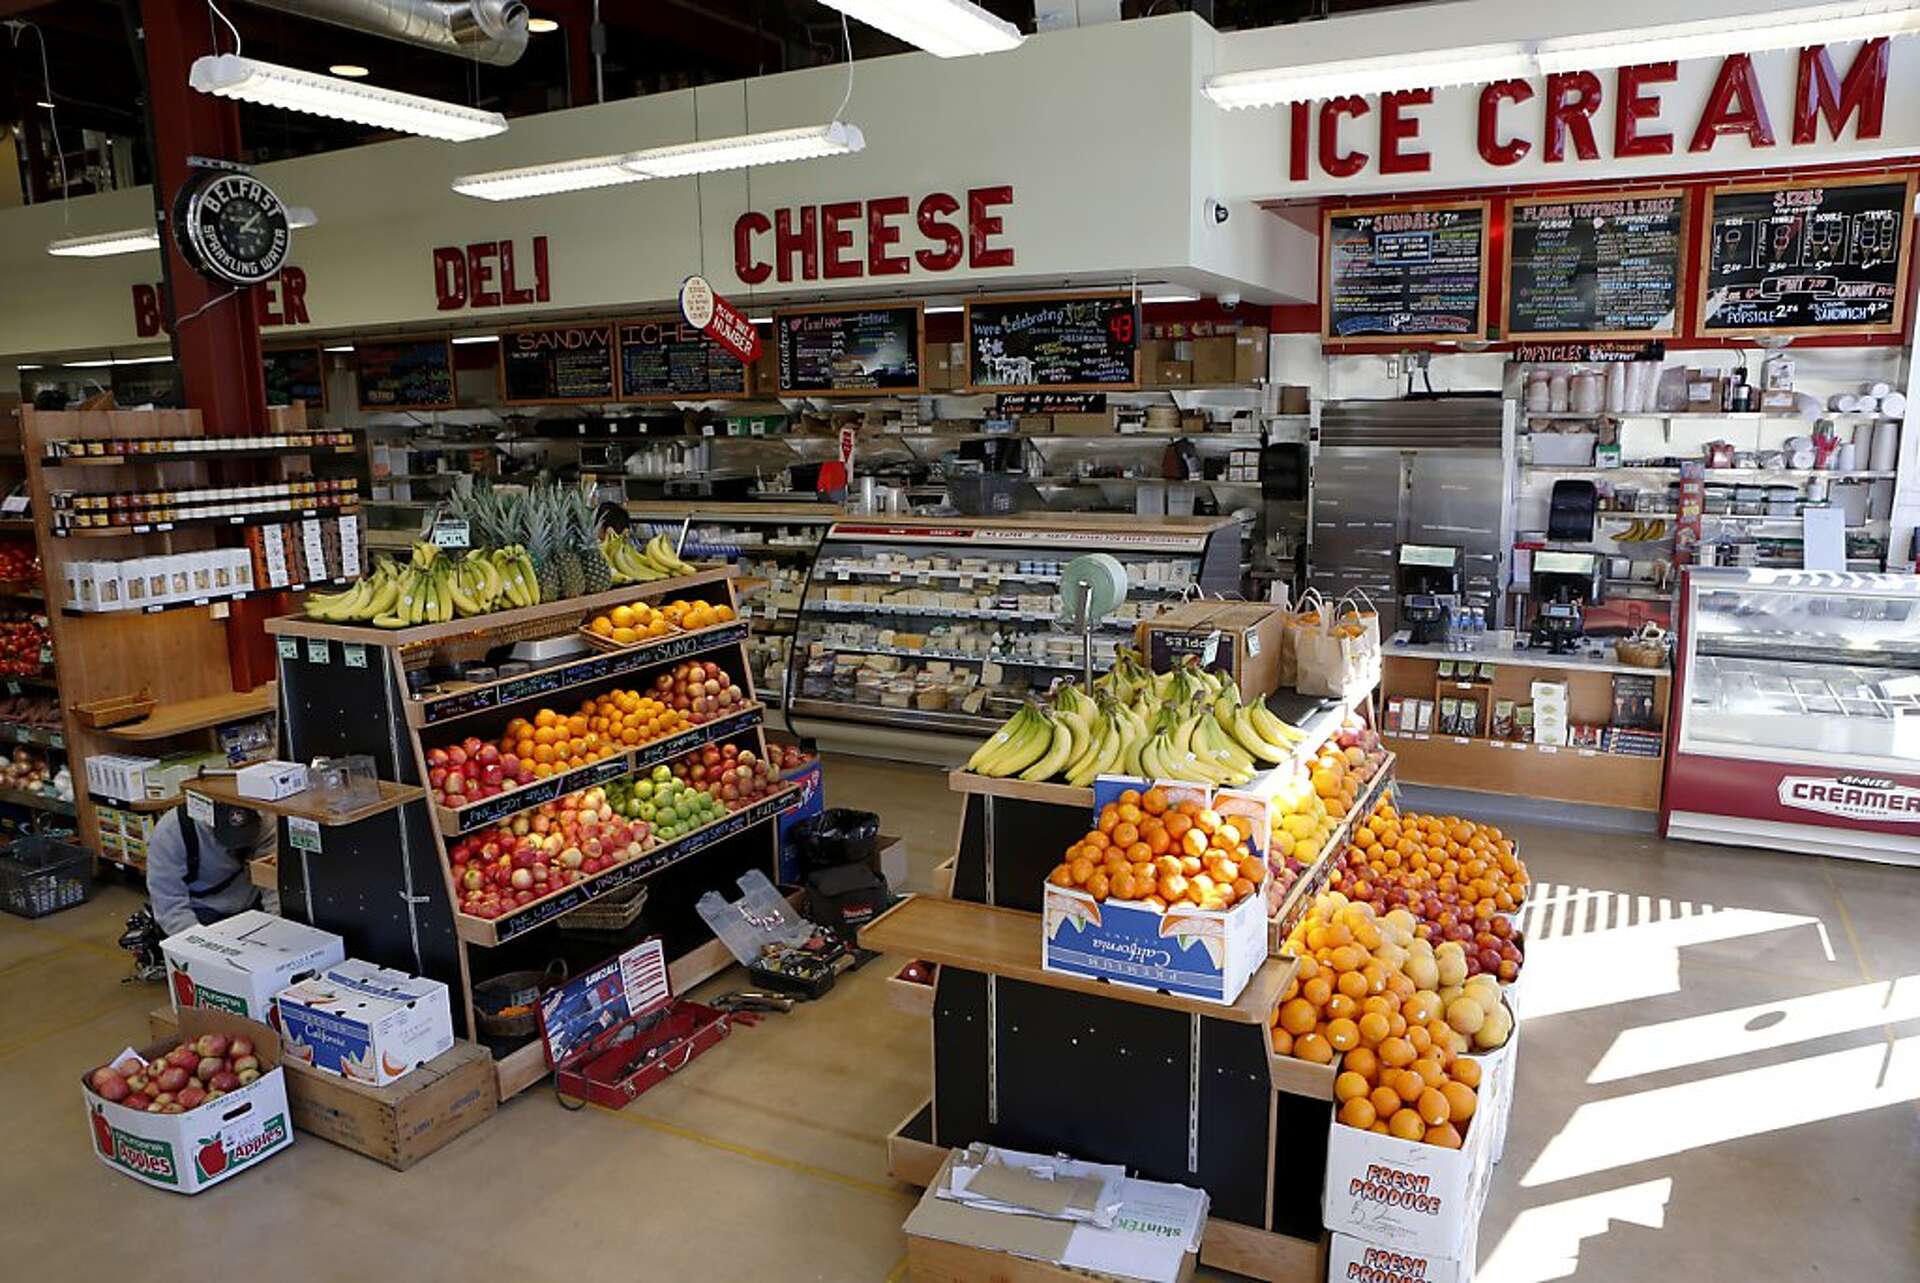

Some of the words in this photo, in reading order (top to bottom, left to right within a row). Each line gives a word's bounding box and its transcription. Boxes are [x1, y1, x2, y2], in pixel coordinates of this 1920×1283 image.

[1289, 88, 1433, 181] ICE
[1476, 37, 1890, 167] CREAM
[203, 180, 282, 217] BELFAST
[1523, 204, 1570, 221] FLAVORS
[1573, 202, 1624, 217] TOPPINGS
[734, 185, 1014, 285] CHEESE
[1373, 213, 1440, 233] SUNDAES
[203, 224, 258, 275] SPARKLING
[260, 228, 286, 271] WATER
[433, 236, 550, 311] DELI
[1777, 279, 1804, 292] PINT
[1110, 314, 1133, 343] 43
[1727, 311, 1776, 324] POPSICLE
[1815, 307, 1867, 322] SANDWICH
[622, 325, 713, 345] ICHE
[712, 315, 753, 356] NUMBER
[1517, 345, 1582, 362] POPSICLES
[655, 640, 697, 661] SUMO
[1165, 636, 1206, 649] PPLES
[1093, 938, 1171, 969] California
[304, 1024, 347, 1048] California
[119, 1140, 171, 1175] Apples
[235, 1126, 283, 1160] Apples
[1366, 1164, 1431, 1194] FRESH
[1350, 1178, 1441, 1215] PRODUCE
[1364, 1248, 1428, 1278] FRESH
